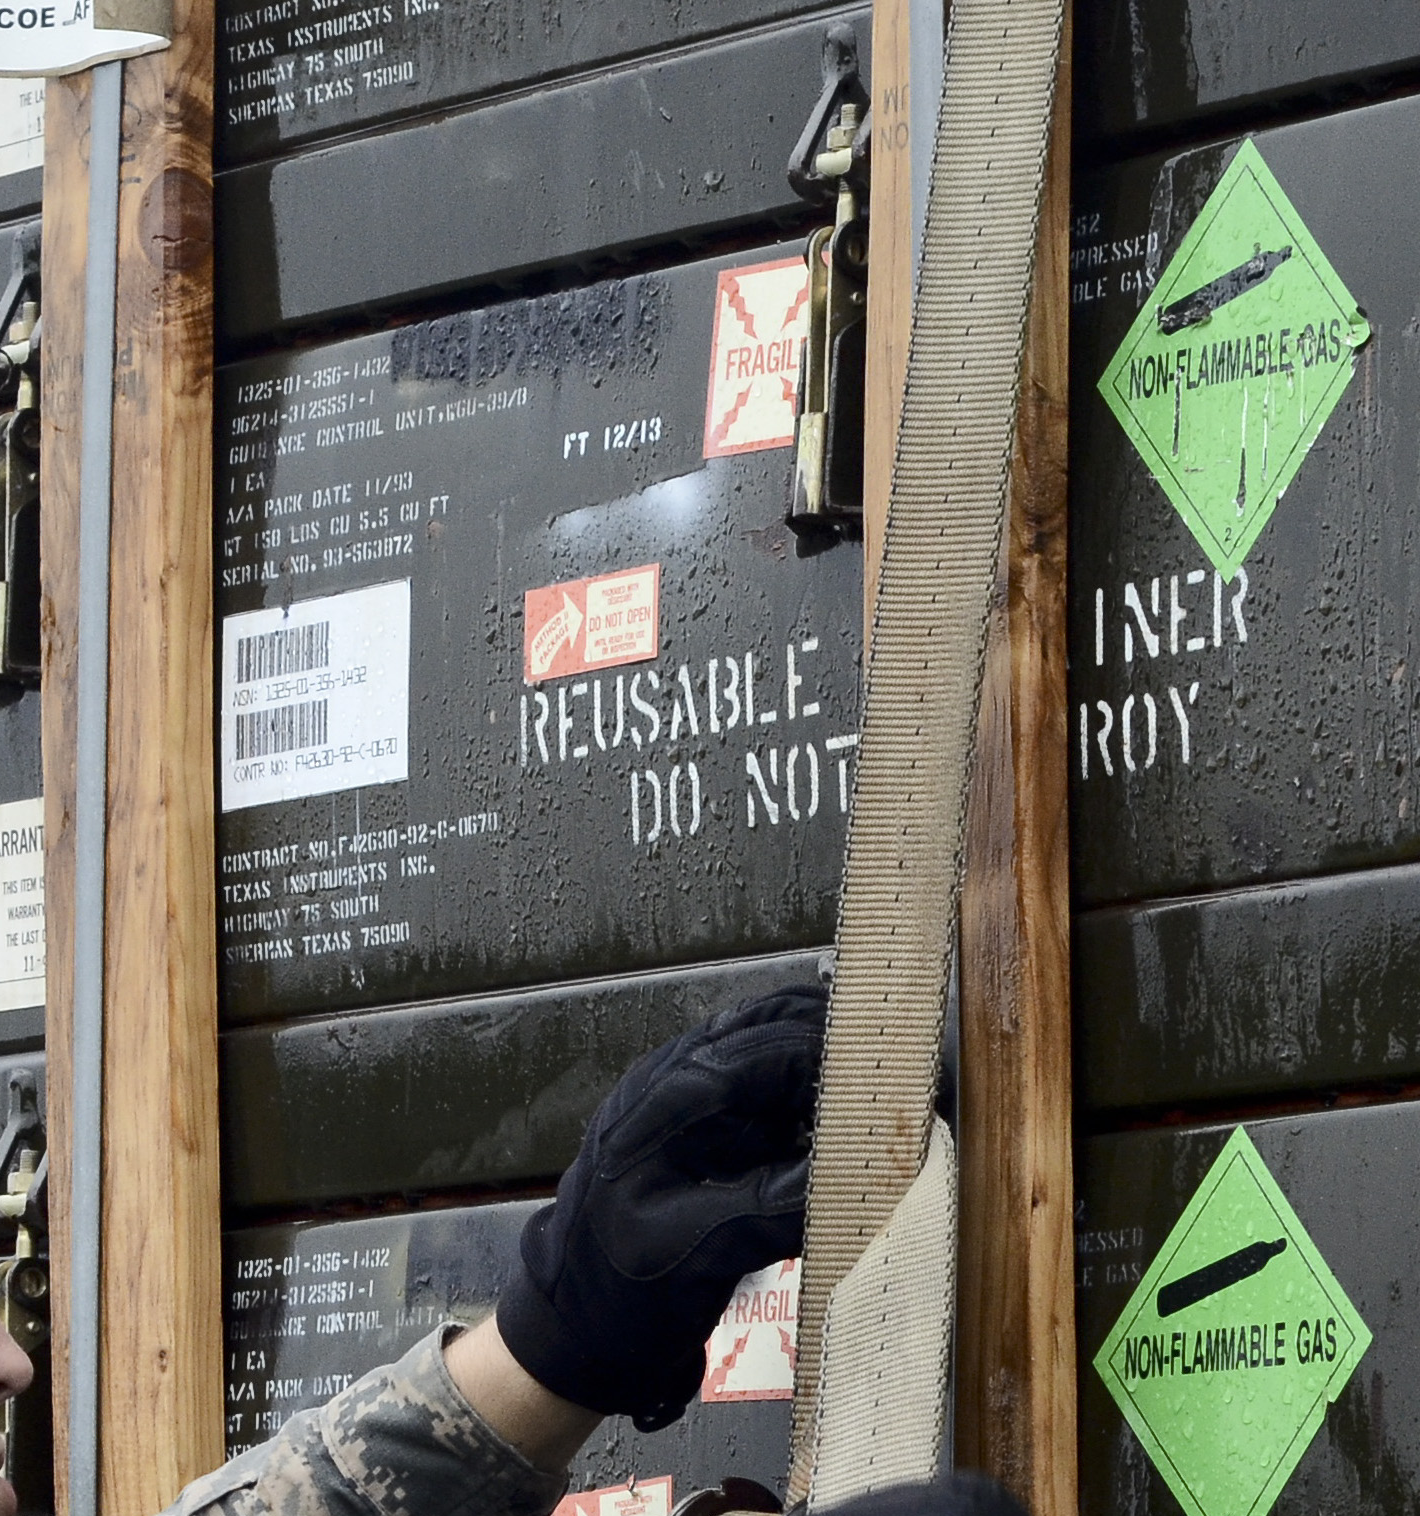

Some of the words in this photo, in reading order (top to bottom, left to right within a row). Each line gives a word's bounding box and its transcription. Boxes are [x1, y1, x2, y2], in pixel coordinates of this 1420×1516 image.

[229, 37, 275, 64] TEXAS
[288, 5, 392, 48] INSTRUMENTS
[228, 61, 295, 94] HIGHWAY
[305, 53, 324, 75] 75
[333, 37, 384, 67] SOUTH
[19, 90, 33, 108] THE
[229, 91, 295, 125] SHERMAN
[305, 78, 354, 106] TEXAS
[362, 61, 414, 90] 75090
[1129, 328, 1291, 400] NON-FLAMMABLE
[1298, 318, 1341, 369] GAS
[238, 355, 391, 403] 1325-01-356-1432
[317, 419, 384, 447] CONTROL
[564, 431, 589, 459] FT
[604, 417, 661, 450] 12/13
[245, 472, 265, 490] EA
[226, 505, 254, 525] A/A
[265, 493, 302, 518] PACK
[313, 484, 351, 507] DATE
[331, 515, 350, 536] CU
[400, 501, 419, 521] CU
[430, 495, 449, 516] FT
[1224, 527, 1232, 542] 2
[223, 561, 279, 586] SERIAL
[589, 616, 600, 632] DO
[605, 612, 622, 628] NOT
[627, 606, 651, 624] OPEN
[540, 623, 569, 664] PACKAGE
[520, 637, 820, 767] REUSABLE
[1080, 682, 1199, 780] ROY
[234, 762, 265, 783] CONTR
[631, 762, 700, 845] DO
[747, 734, 858, 827] NOT
[222, 844, 299, 873] CONTRACT
[3, 880, 17, 895] THIS
[20, 878, 37, 892] ITEM
[224, 880, 271, 903] TEXAS
[284, 862, 387, 895] INSTRUMENTS
[401, 855, 436, 877] INC.
[224, 907, 290, 933] HIGHWAY
[301, 904, 320, 925] 75
[331, 895, 379, 920] SOUTH
[6, 933, 18, 947] THE
[21, 930, 38, 945] LAST
[302, 931, 351, 956] TEXAS
[361, 921, 410, 948] 75090
[237, 1248, 390, 1279] 1325-01-356-1432
[317, 1307, 383, 1334] CONTROL
[247, 1350, 266, 1370] EA
[1124, 1322, 1285, 1380] NON-FLAMMABLE
[1296, 1318, 1337, 1365] GAS
[265, 1378, 303, 1400] PACK
